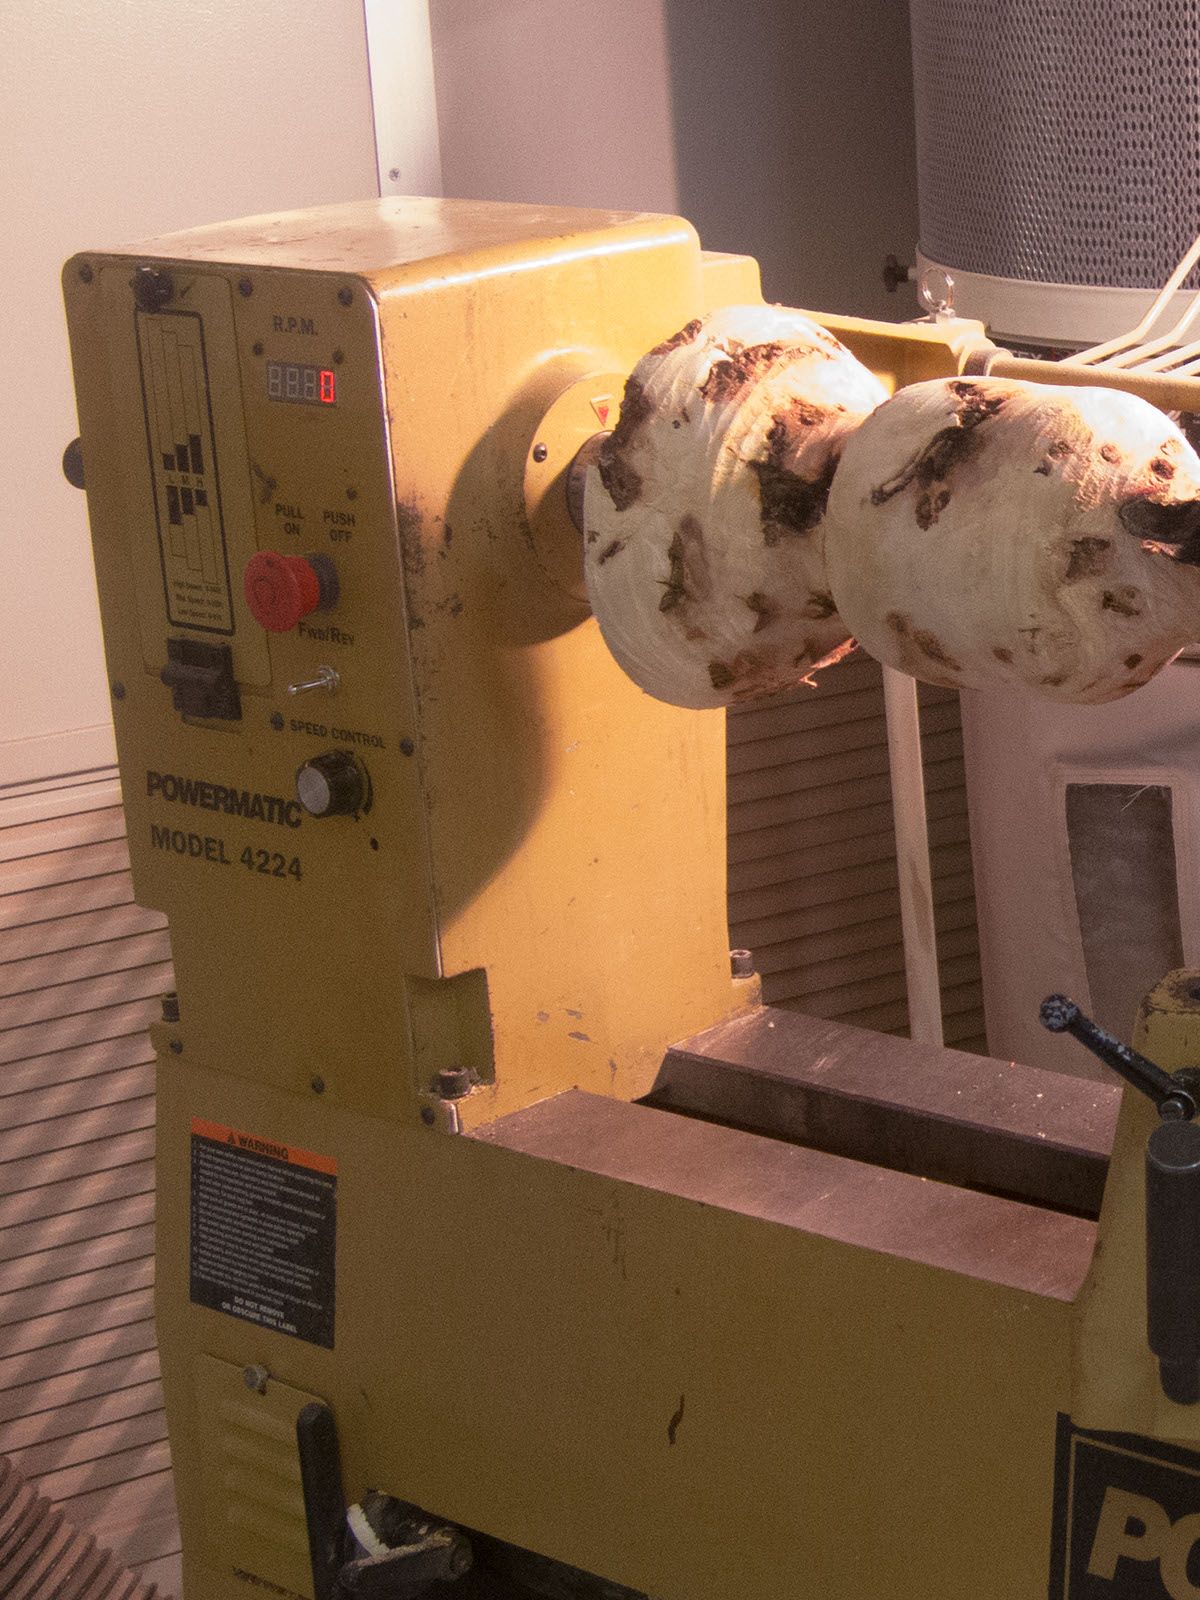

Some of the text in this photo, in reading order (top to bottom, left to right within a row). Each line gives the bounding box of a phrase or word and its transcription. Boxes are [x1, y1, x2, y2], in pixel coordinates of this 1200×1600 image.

[272, 315, 318, 336] R.P.M.
[275, 503, 305, 520] PULL
[323, 510, 356, 527] PUSH
[284, 522, 300, 536] ON
[329, 528, 351, 543] OFF
[289, 718, 387, 750] SPEED CONTROL
[146, 770, 302, 829] POWERMATIC
[150, 824, 303, 882] MODEL 4224
[239, 1137, 289, 1160] WARNING
